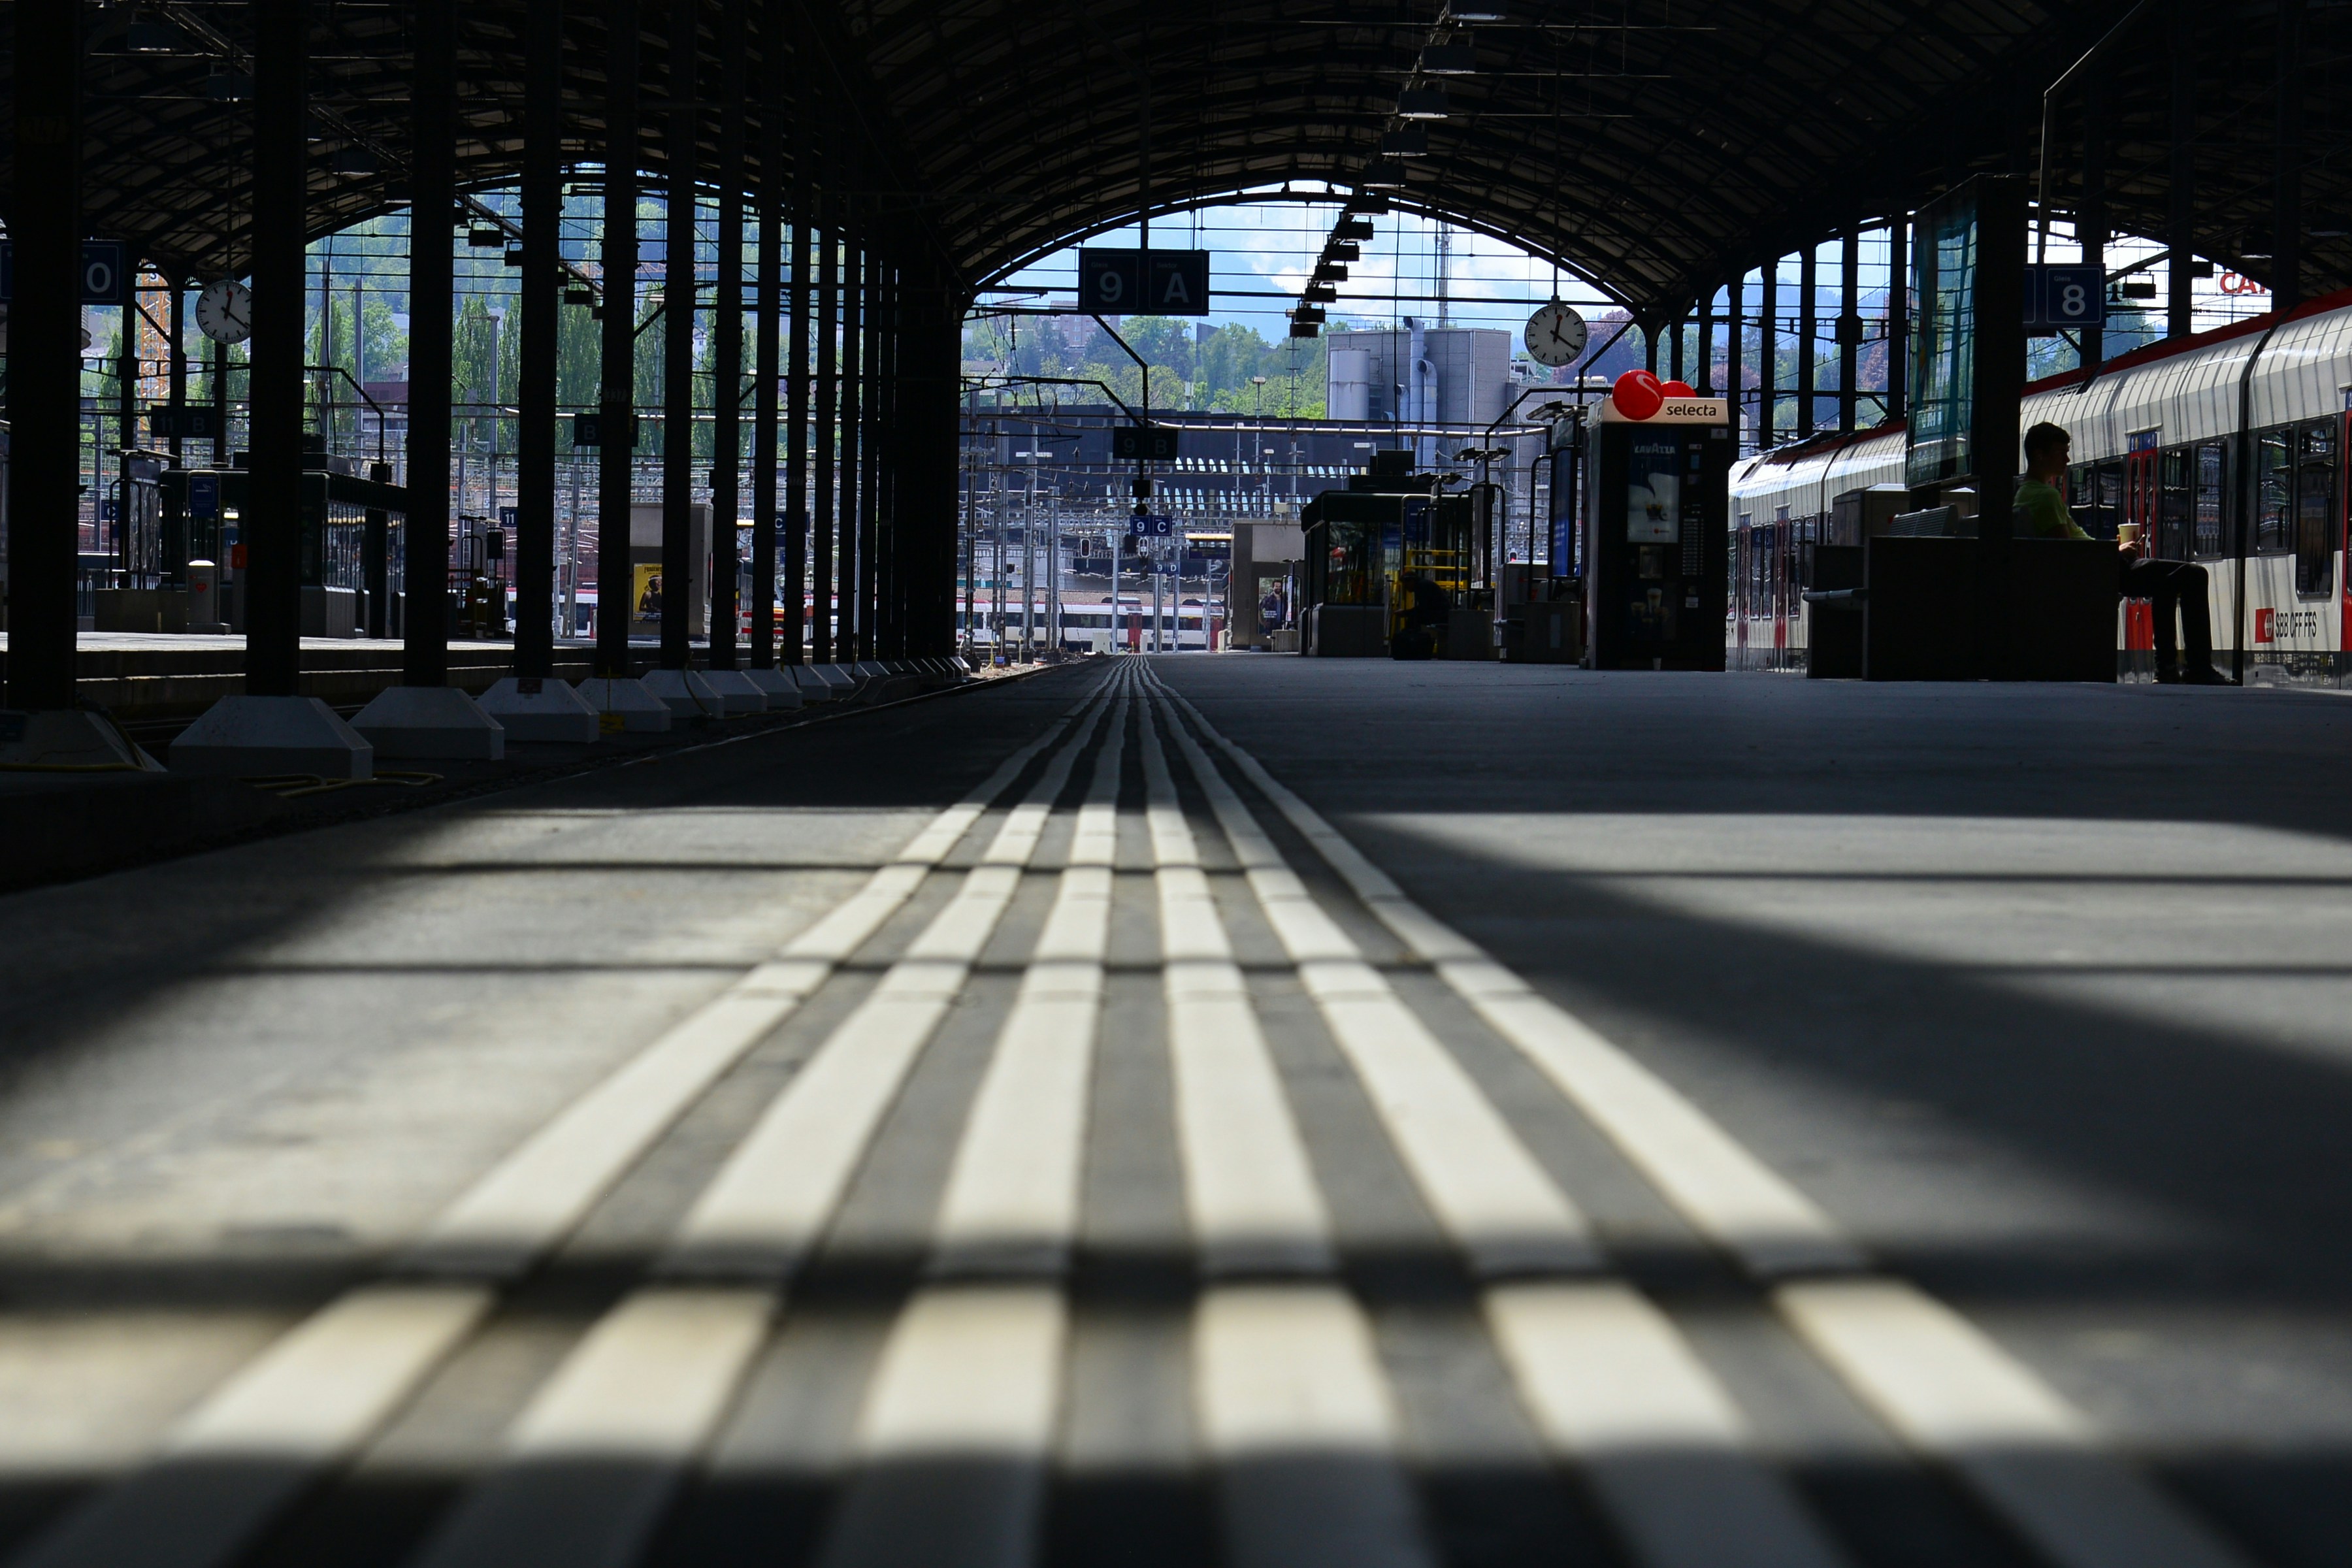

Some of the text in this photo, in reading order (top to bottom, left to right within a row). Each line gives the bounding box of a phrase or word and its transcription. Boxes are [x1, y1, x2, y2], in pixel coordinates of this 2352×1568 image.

[1099, 271, 1122, 303] 9
[1163, 272, 1190, 304] A
[2220, 273, 2264, 294] CA
[2062, 284, 2085, 316] 8
[1666, 404, 1716, 416] selecta
[159, 416, 173, 432] 11
[193, 417, 205, 433] B
[583, 424, 596, 441] B
[1124, 438, 1135, 453] 9
[1155, 438, 1168, 455] B
[1635, 442, 1676, 454] LAVAZZA
[505, 514, 514, 524] 11
[775, 517, 783, 529] C
[1137, 522, 1145, 532] 9
[1157, 522, 1166, 532] C
[2276, 610, 2317, 638] SBB CFF FFS
